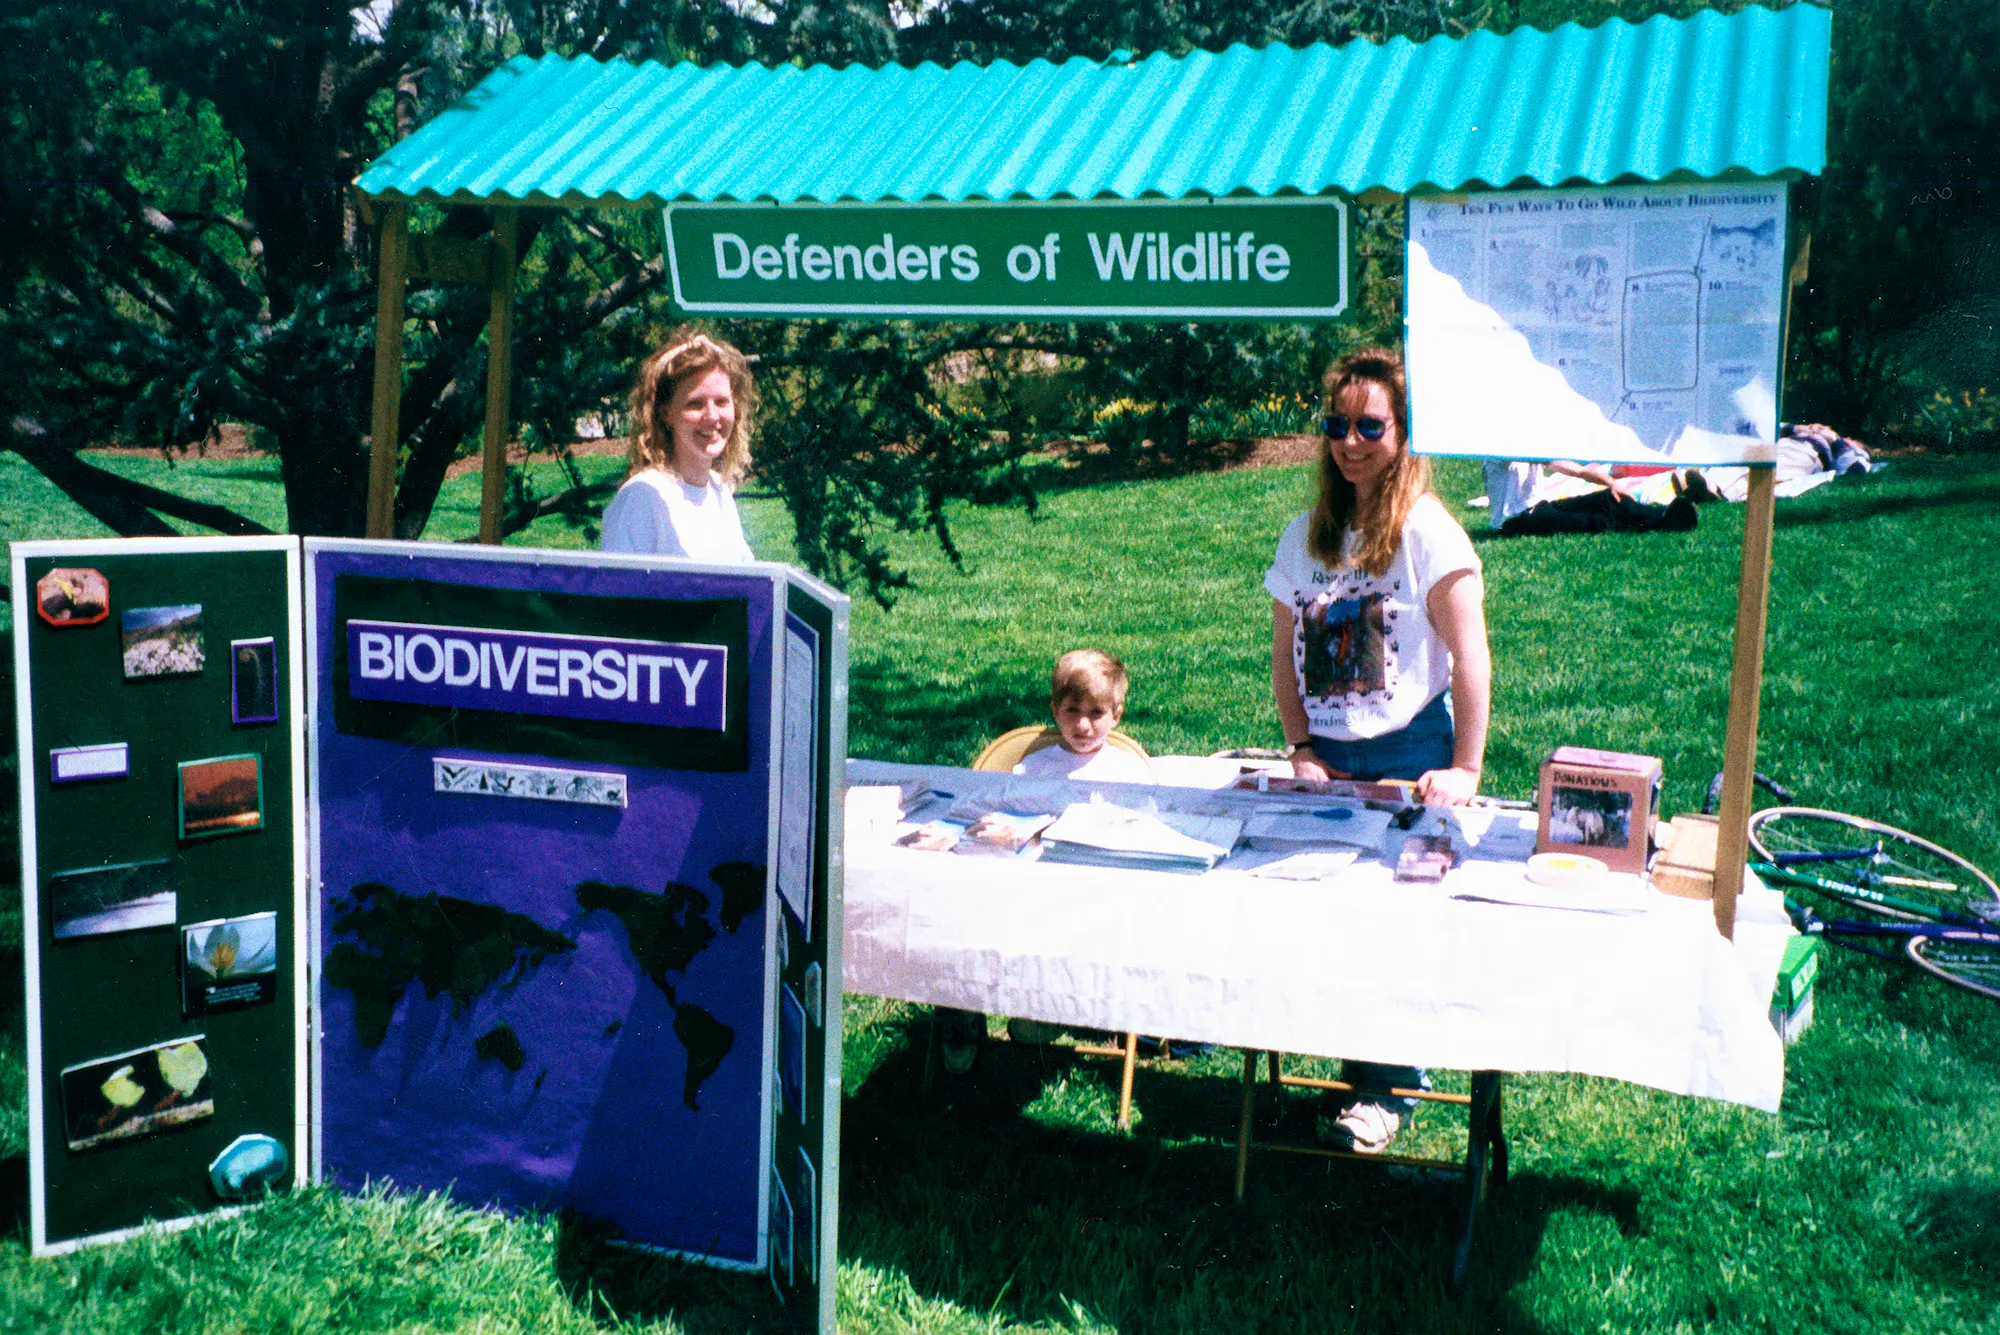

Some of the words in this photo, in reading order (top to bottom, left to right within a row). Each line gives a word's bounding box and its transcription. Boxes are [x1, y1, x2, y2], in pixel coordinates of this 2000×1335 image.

[1556, 199, 1574, 211] TO
[1578, 196, 1599, 210] GO
[712, 232, 981, 284] Defenders
[1006, 232, 1061, 284] of
[1087, 231, 1291, 284] Wildlife
[358, 631, 709, 706] BIODIVERSITY
[1553, 771, 1618, 788] DONATIONS
